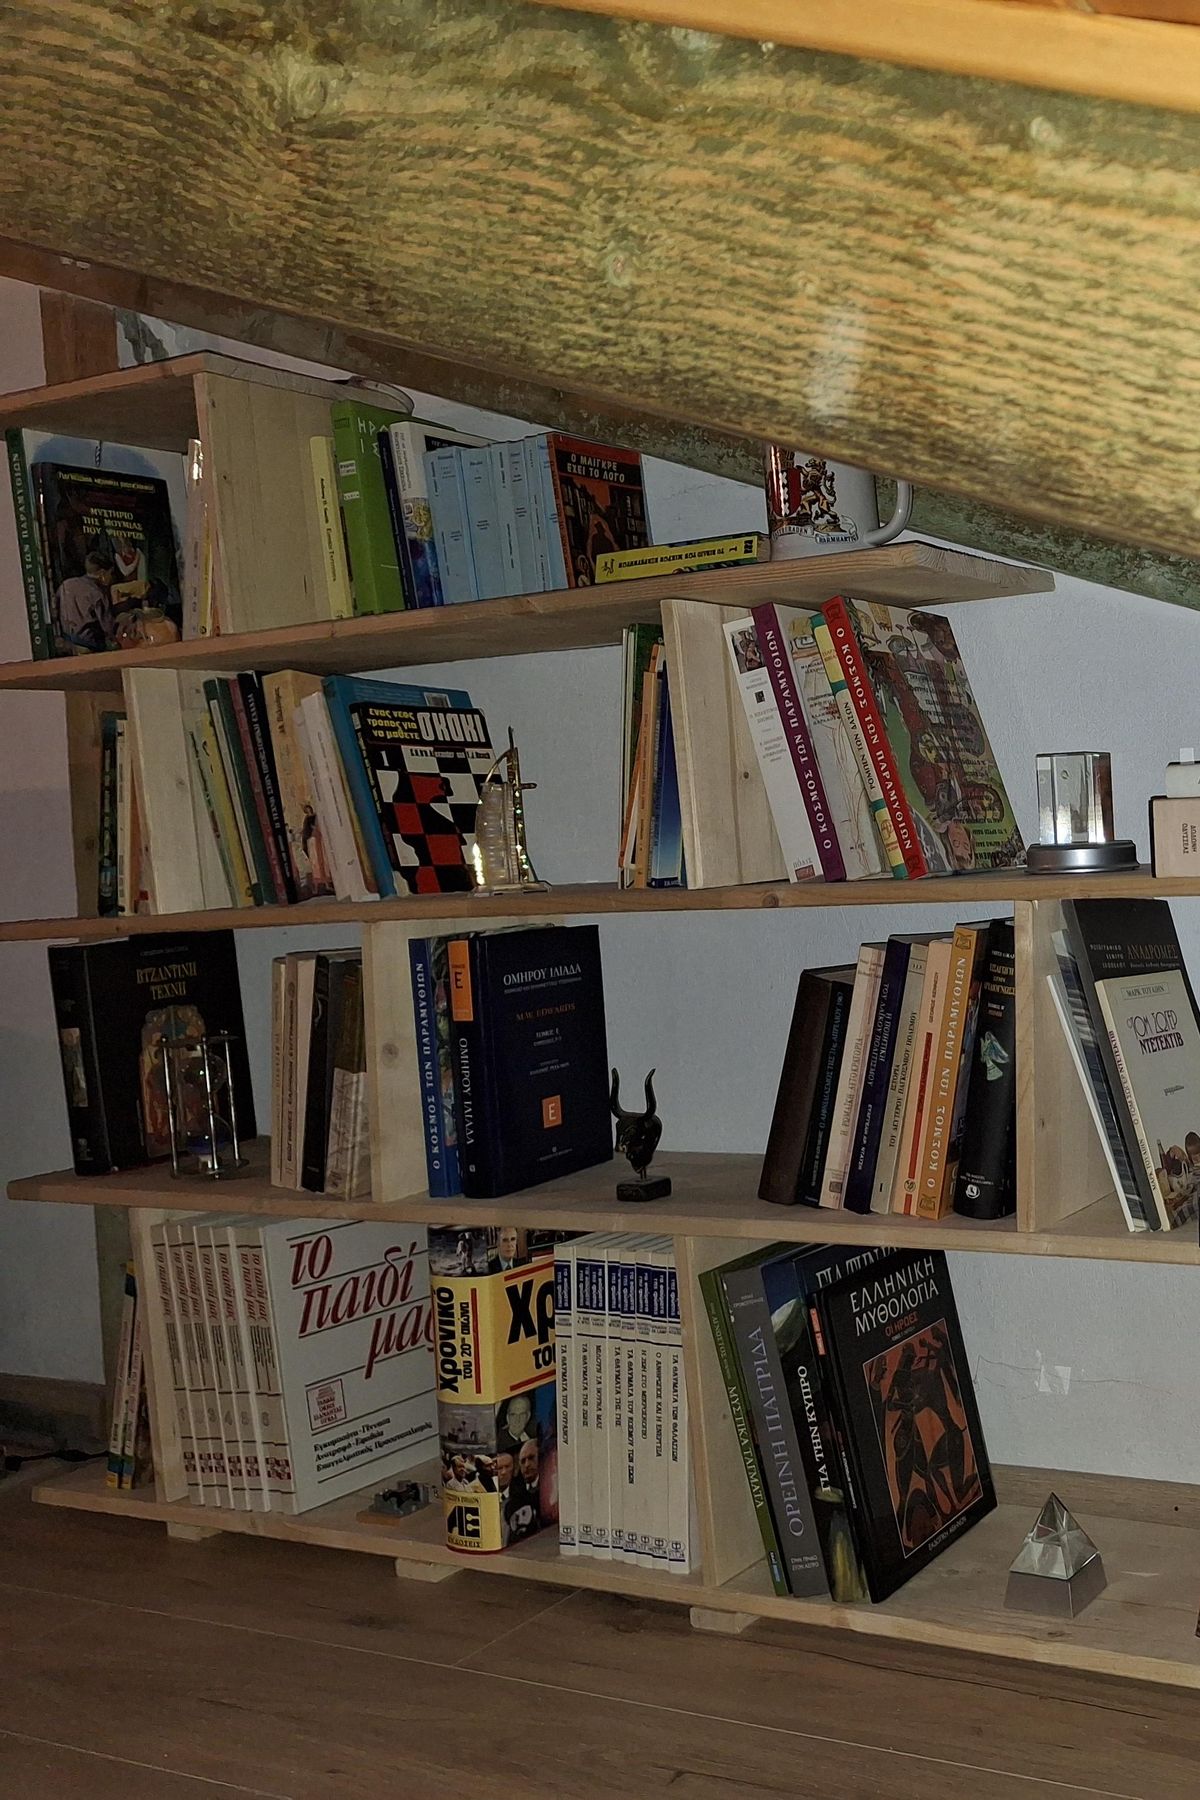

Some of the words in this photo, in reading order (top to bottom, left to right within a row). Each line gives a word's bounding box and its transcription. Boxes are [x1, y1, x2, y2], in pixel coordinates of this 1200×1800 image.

[567, 463, 587, 476] ΕΧΕΙ
[589, 467, 600, 477] ΤΟ
[602, 470, 626, 482] ΛΟΓΟ
[579, 454, 618, 470] ΜΑΙΓΚΡΕ
[12, 453, 29, 538] ΠΑΡΑΜΥΘΙΩΝ
[22, 544, 32, 571] ΤΩΝ
[28, 576, 41, 632] ΚΟΣΜΟΣ
[765, 629, 799, 728] ΠΑΡΑΜΥΘΙΩΝ
[794, 734, 809, 765] ΤΩΝ
[836, 627, 846, 638] Ο
[841, 643, 869, 709] ΚΟΣΜΟΣ
[865, 714, 880, 745] ΤΩΝ
[875, 750, 913, 851] ΠΑΡΑΜΥΘΙΩΝ
[805, 770, 829, 833] ΚΟΣΜΟΣ
[823, 839, 832, 849] Ο
[150, 981, 187, 1001] ΤΕΧΝΗ
[503, 967, 547, 986] ΟΜΗΡΟΥ
[550, 963, 582, 978] ΙΛΙΑΔΑ
[415, 963, 432, 1054] ΠΑΡΑΜΥΘΙΩΝ
[904, 1010, 917, 1047] ΠΟΛΕΜΟΥ
[944, 956, 967, 1060] ΠΑΡΑΜΥΘΙΩΝ
[459, 1037, 472, 1094] ΟΜΗΡΟΥ
[1138, 1032, 1184, 1056] ΝΤΕΤΕΚΤΙΒ
[425, 1060, 434, 1088] ΤΩΝ
[896, 1049, 910, 1094] ΠΑΓΚΟΣΜΙΟΥ
[938, 1067, 950, 1097] ΤΩΝ
[428, 1095, 439, 1153] ΚΟΣΜΟΣ
[464, 1097, 474, 1145] ΙΛΙΑΔΑ
[891, 1096, 903, 1131] ΔΕΥΤΕΡΟΥ
[929, 1104, 947, 1172] ΚΟΣΜΟΣ
[432, 1160, 440, 1169] Ο
[927, 1177, 936, 1188] Ο
[290, 1234, 333, 1286] το
[850, 1255, 935, 1313] ΕΛΛΗΝΙΚΗ
[298, 1241, 417, 1335] παιδί
[855, 1279, 939, 1336] ΜΥΘΟΛΟΓΙΑ
[433, 1286, 462, 1394] Χρονικό
[457, 1301, 471, 1336] αιώνα
[462, 1360, 473, 1380] του
[748, 1326, 783, 1433] ΠΑΤΡΙΔΑ
[797, 1365, 817, 1420] ΚΥΠΡΟ
[728, 1385, 749, 1446] ΜΥΣΤΙΚΑ
[742, 1447, 765, 1509] ΤΑΓΜΑΤΑ
[809, 1424, 826, 1462] ΤΗΝ
[777, 1438, 804, 1538] ΟΡΕΙΝΗ
[815, 1464, 832, 1493] ΓΙΑ
